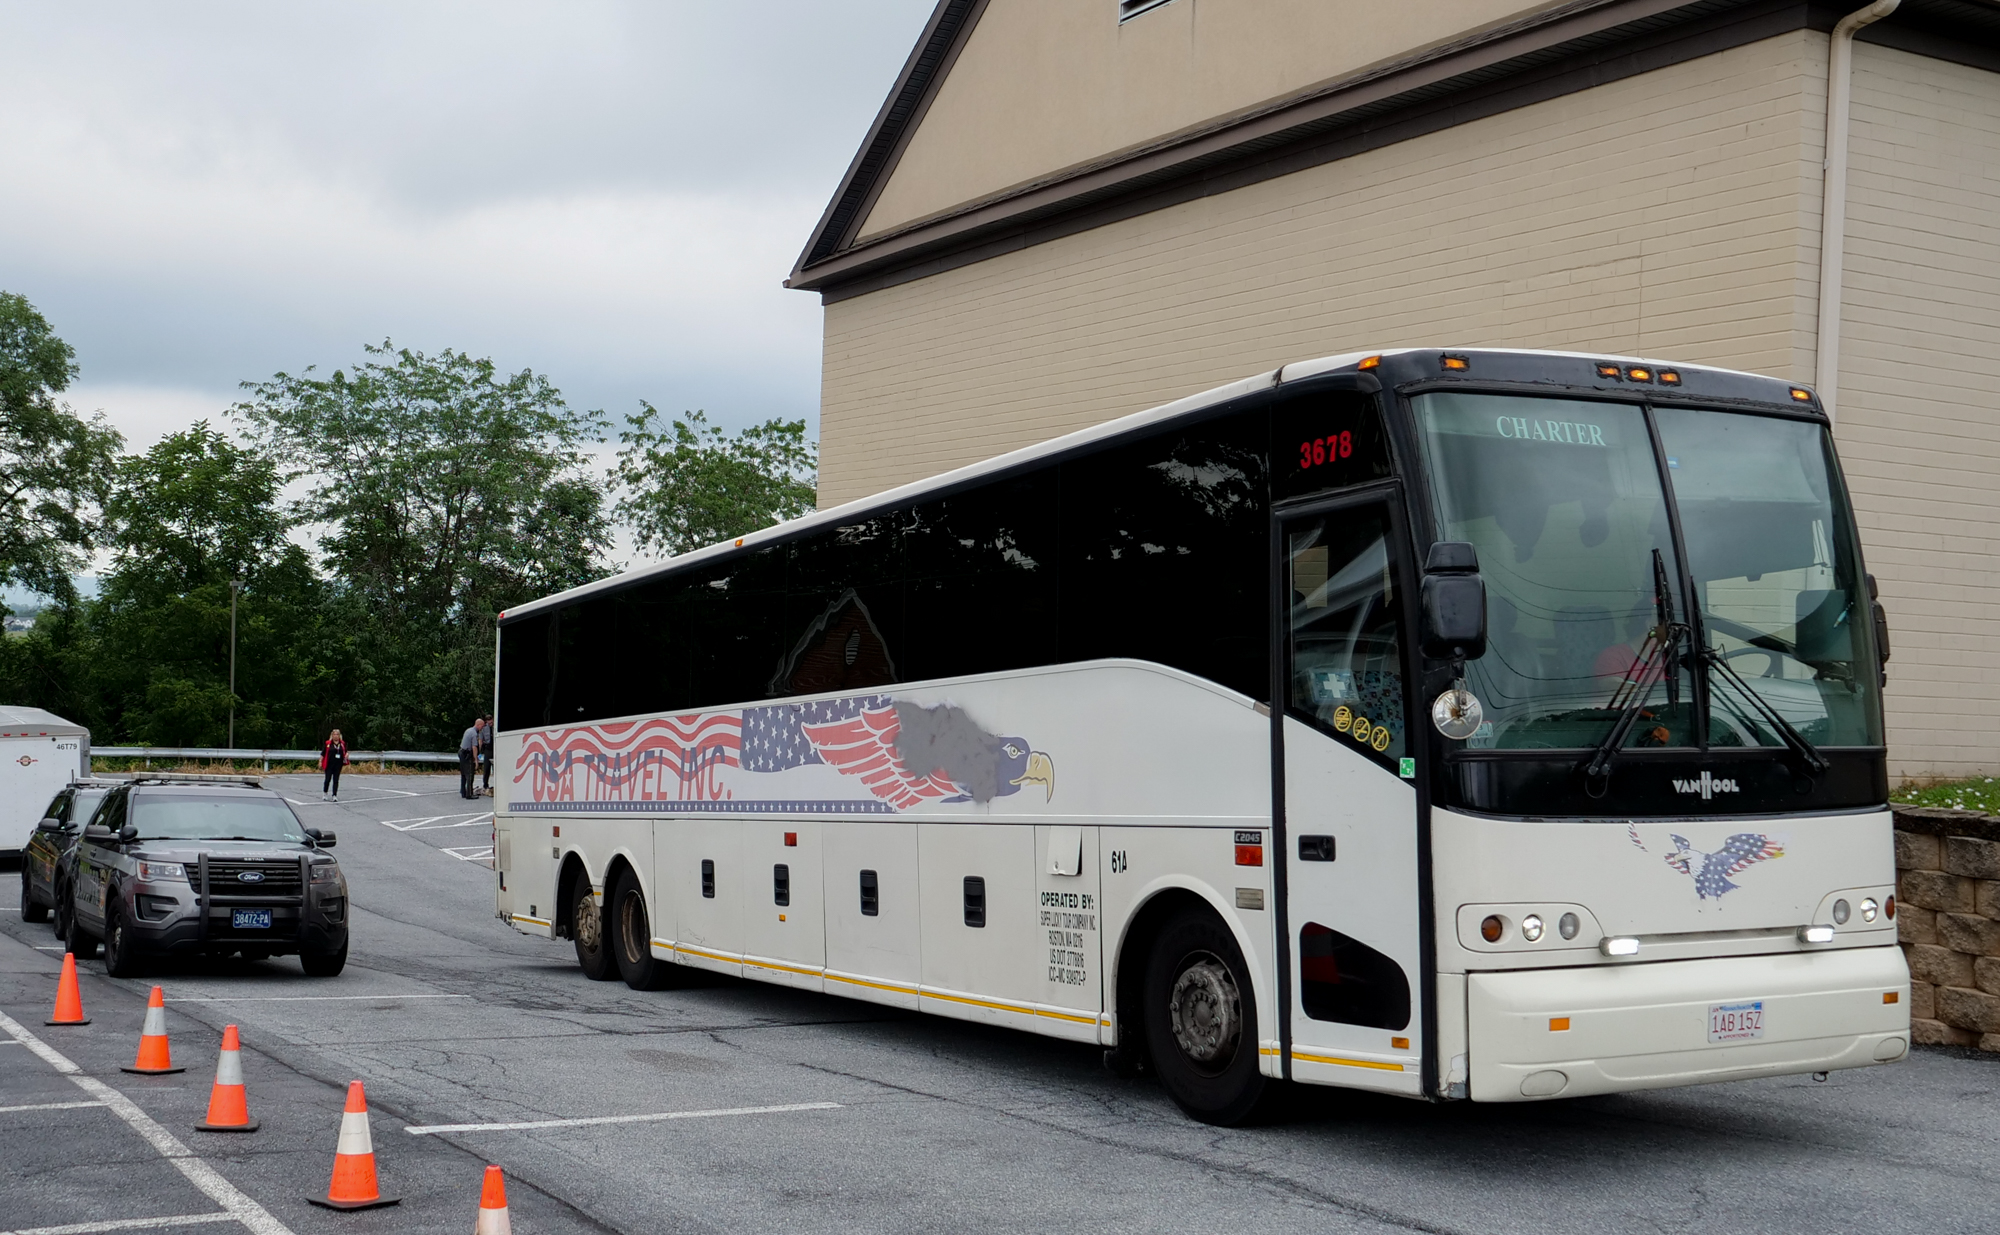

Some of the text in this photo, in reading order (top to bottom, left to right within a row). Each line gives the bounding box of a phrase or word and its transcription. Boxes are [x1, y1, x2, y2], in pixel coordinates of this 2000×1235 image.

[1496, 415, 1606, 446] CHARTER
[1300, 430, 1351, 469] 3678
[533, 744, 732, 803] USA TRAVEL INC.
[1111, 850, 1128, 874] 61A
[1041, 891, 1094, 910] OPERATED BY:
[235, 913, 269, 924] 38472-PA
[1049, 948, 1057, 964] US
[1057, 949, 1066, 965] DOT
[1712, 1011, 1762, 1033] 1AB 15Z
